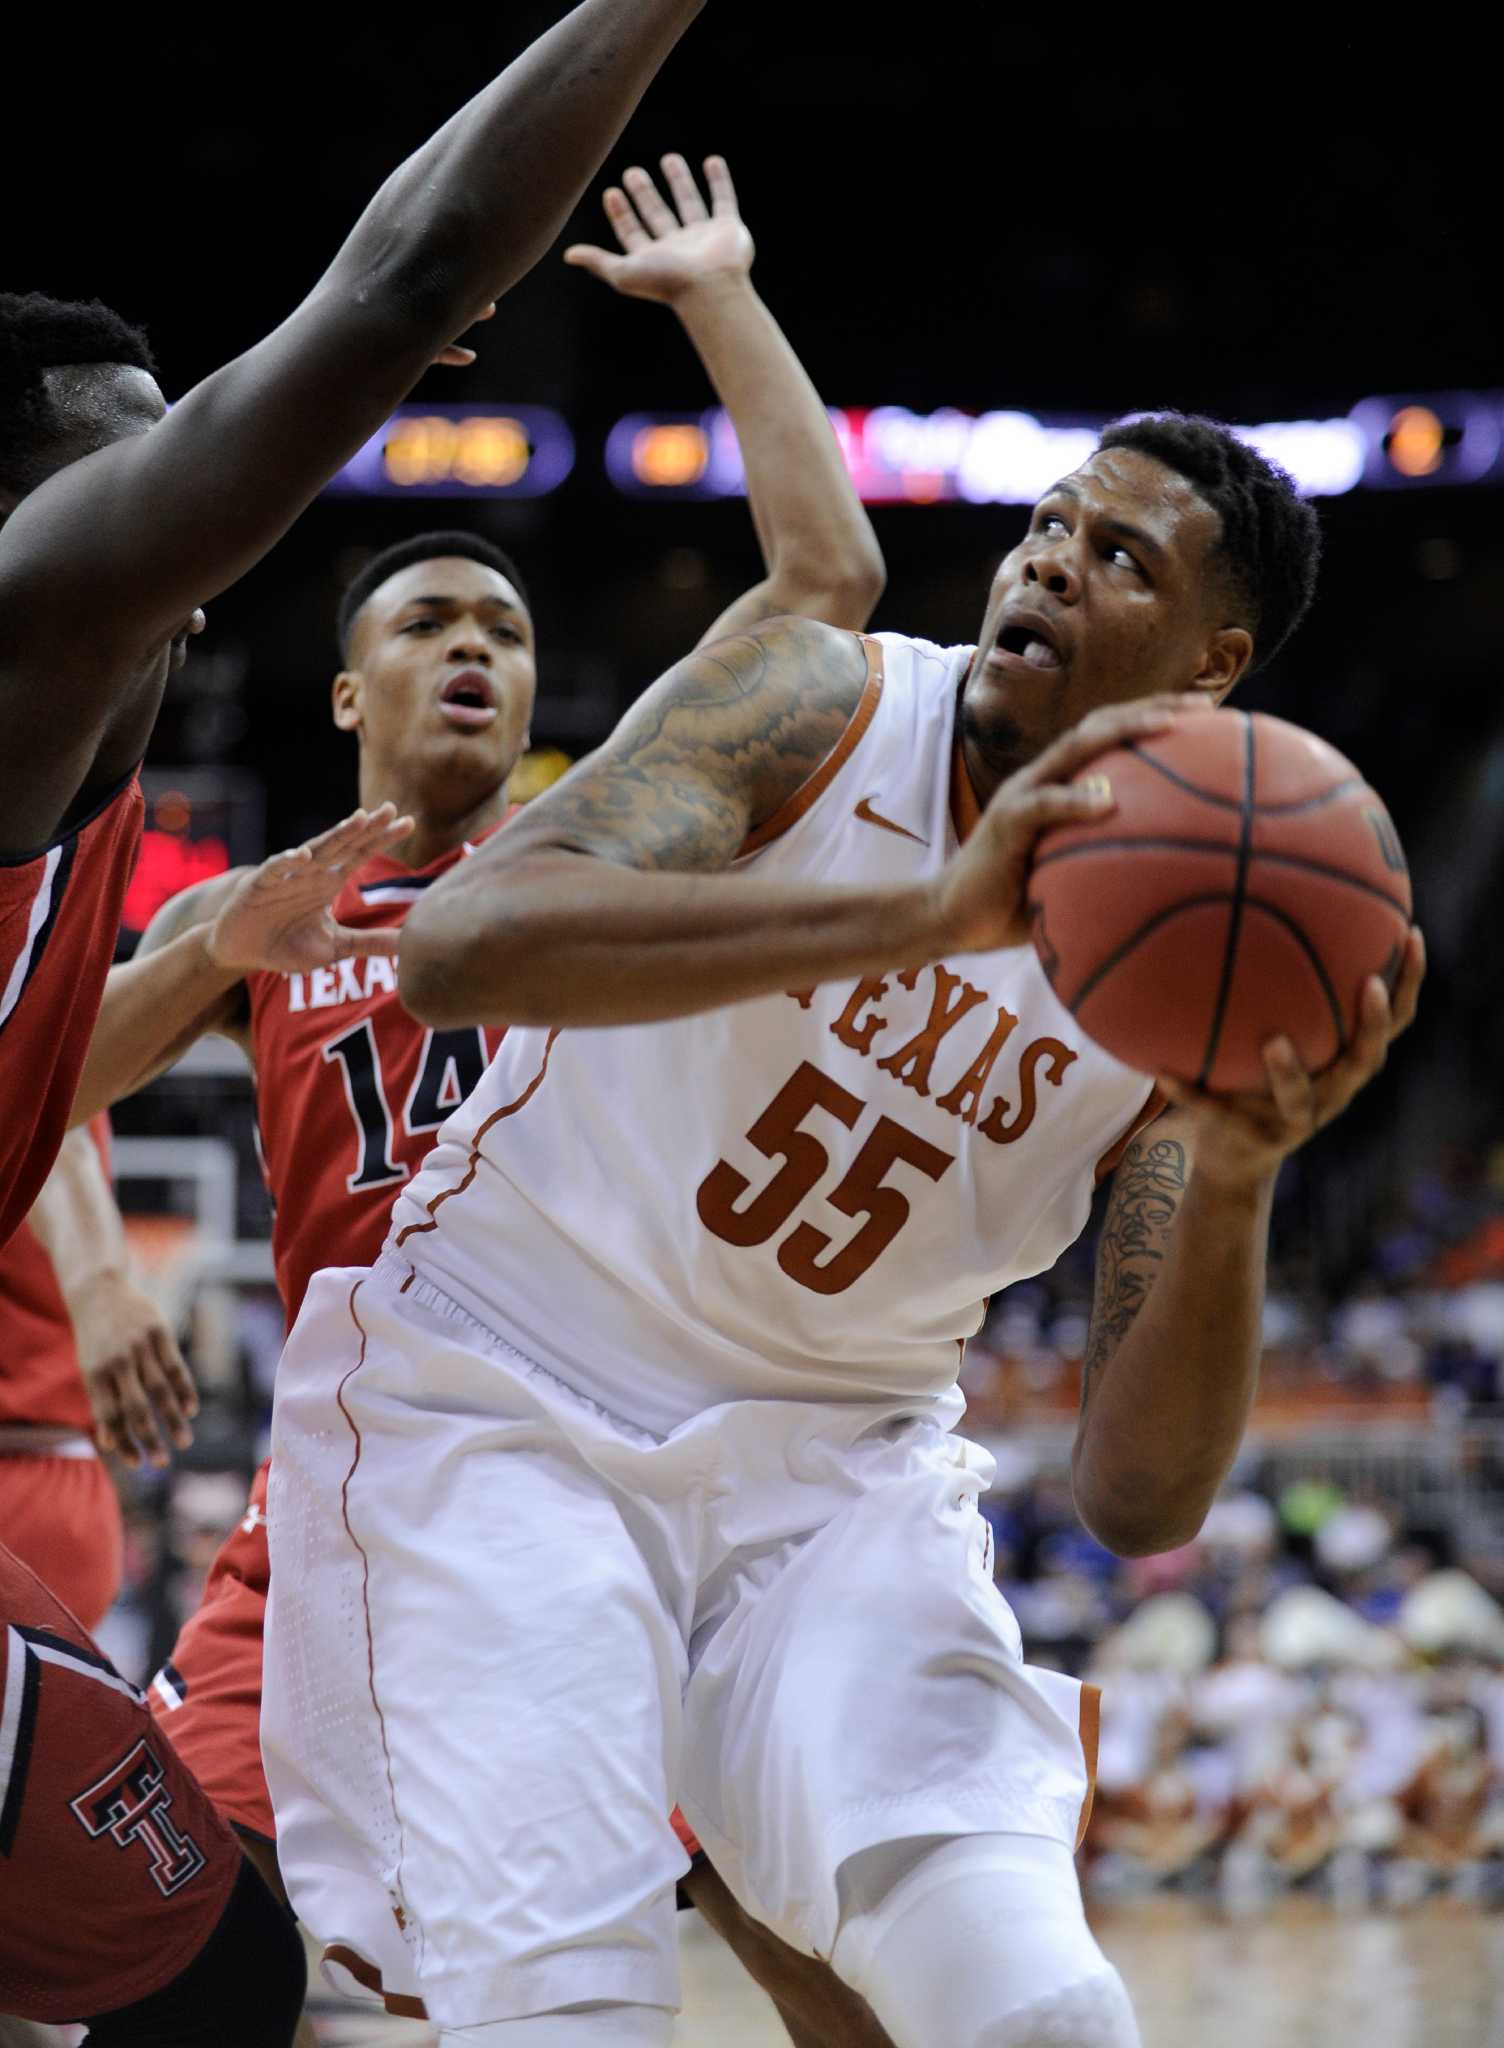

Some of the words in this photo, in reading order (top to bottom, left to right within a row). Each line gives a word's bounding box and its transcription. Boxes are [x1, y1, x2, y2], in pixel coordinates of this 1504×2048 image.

[281, 954, 400, 1013] TEXA
[784, 963, 1079, 1145] EXAS
[321, 1016, 491, 1195] 14
[696, 1059, 956, 1295] 55
